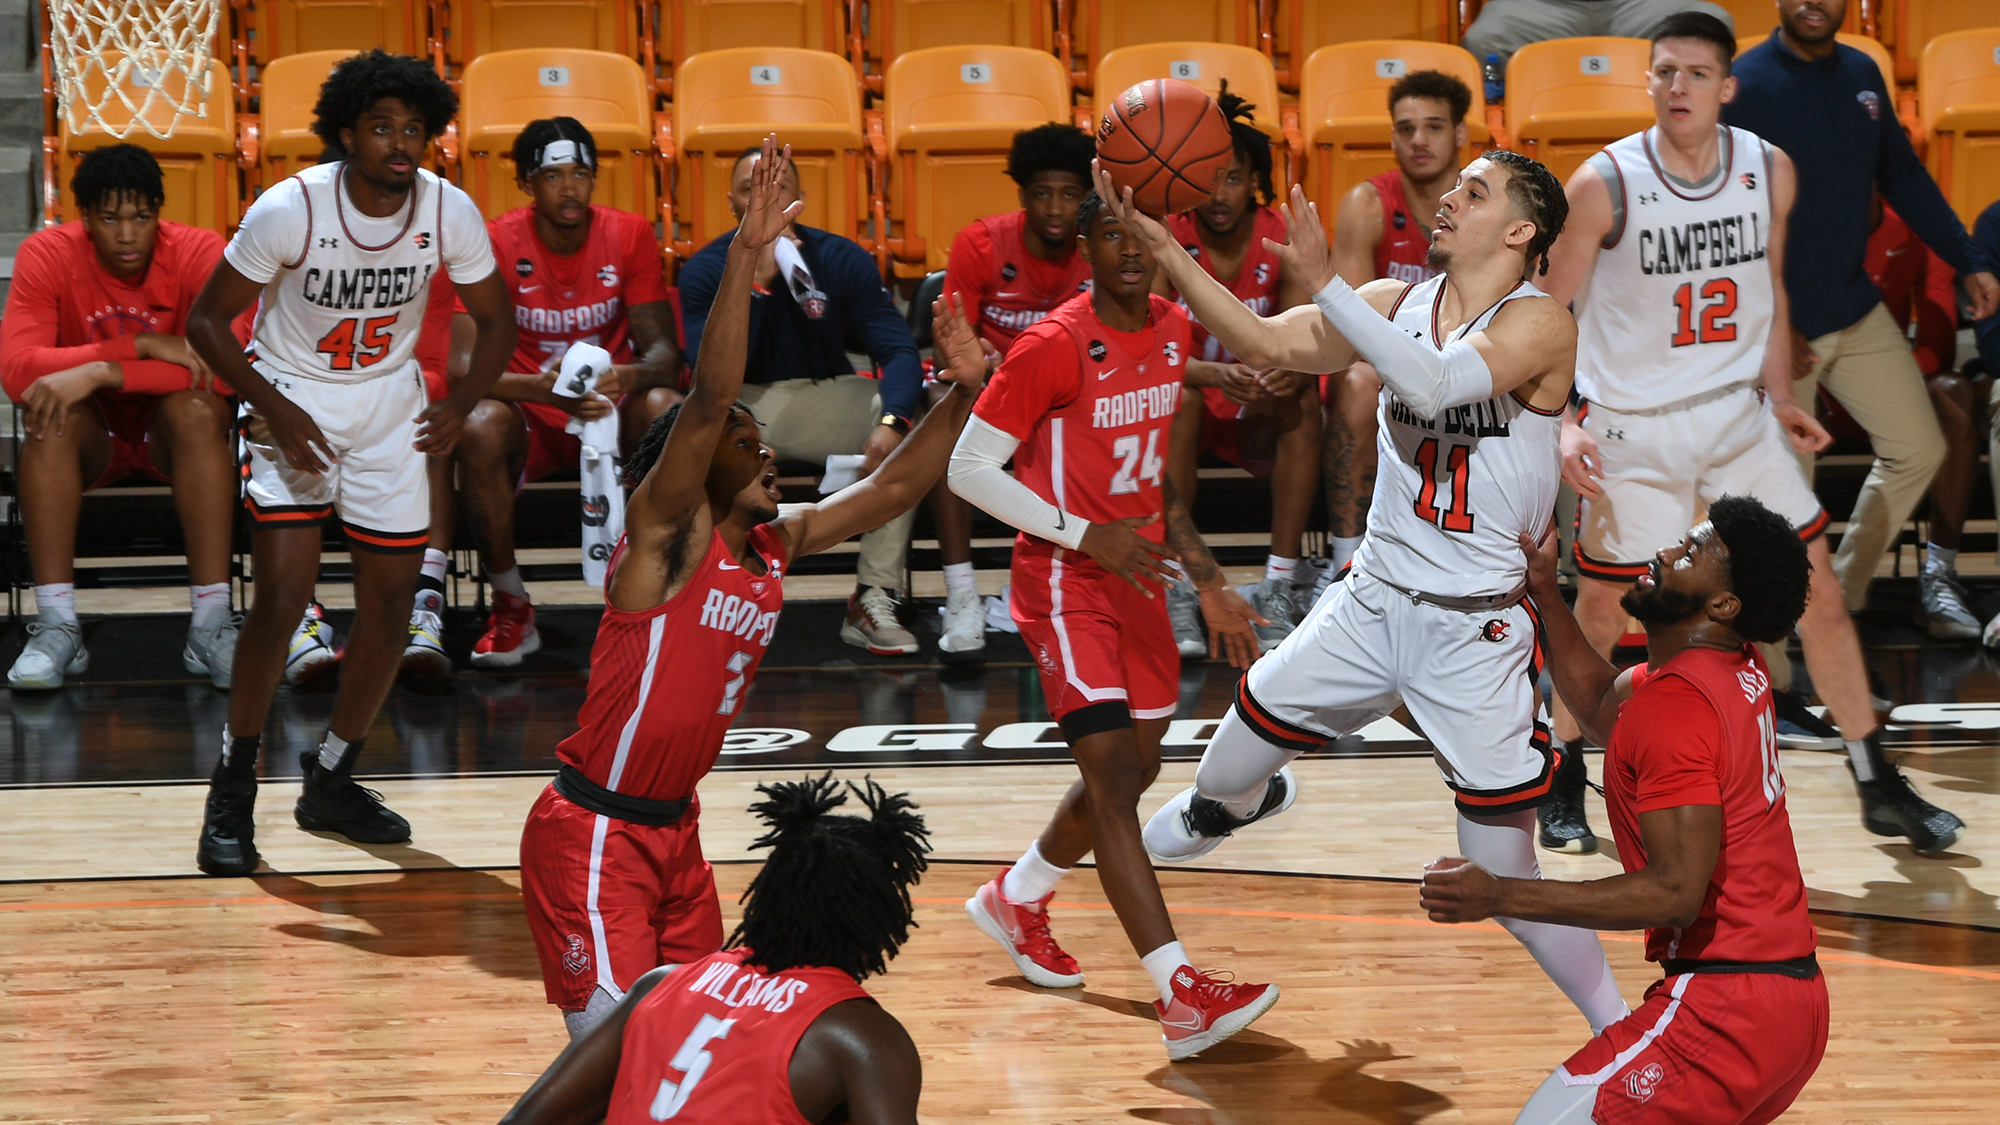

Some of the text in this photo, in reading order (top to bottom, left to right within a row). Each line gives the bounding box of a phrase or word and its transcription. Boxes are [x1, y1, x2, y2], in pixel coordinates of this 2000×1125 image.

[548, 69, 559, 83] 3
[759, 69, 771, 81] 4
[970, 67, 981, 80] 5
[1179, 63, 1189, 76] 6
[1385, 62, 1394, 73] 7
[1589, 58, 1600, 71] 8
[1639, 212, 1765, 275] CAMPBELL
[1671, 277, 1738, 347] 12
[316, 312, 399, 370] 45
[1092, 381, 1181, 428] RADFORD
[1108, 428, 1163, 495] 24
[1413, 437, 1475, 533] 11
[649, 1012, 738, 1122] 5
